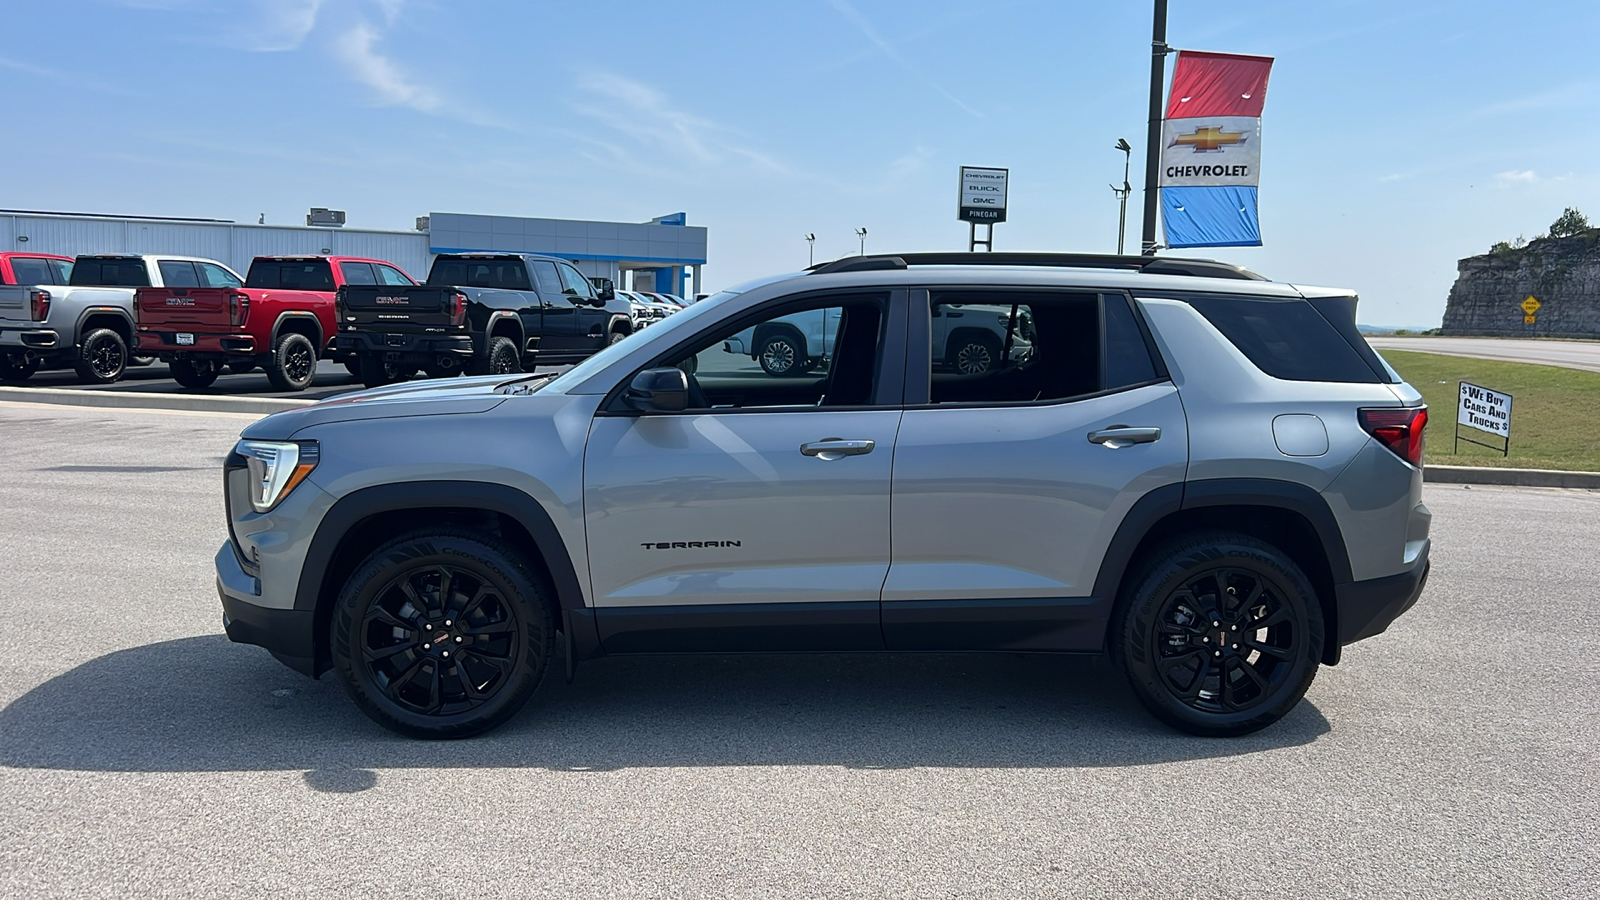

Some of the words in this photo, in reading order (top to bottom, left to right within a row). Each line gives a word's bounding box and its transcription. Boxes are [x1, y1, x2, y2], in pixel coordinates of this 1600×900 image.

[1166, 164, 1248, 178] CHEVROLET
[969, 210, 997, 218] PINEGAR
[166, 298, 195, 306] GMC
[375, 296, 409, 305] GMC
[640, 540, 742, 550] TERRAIN
